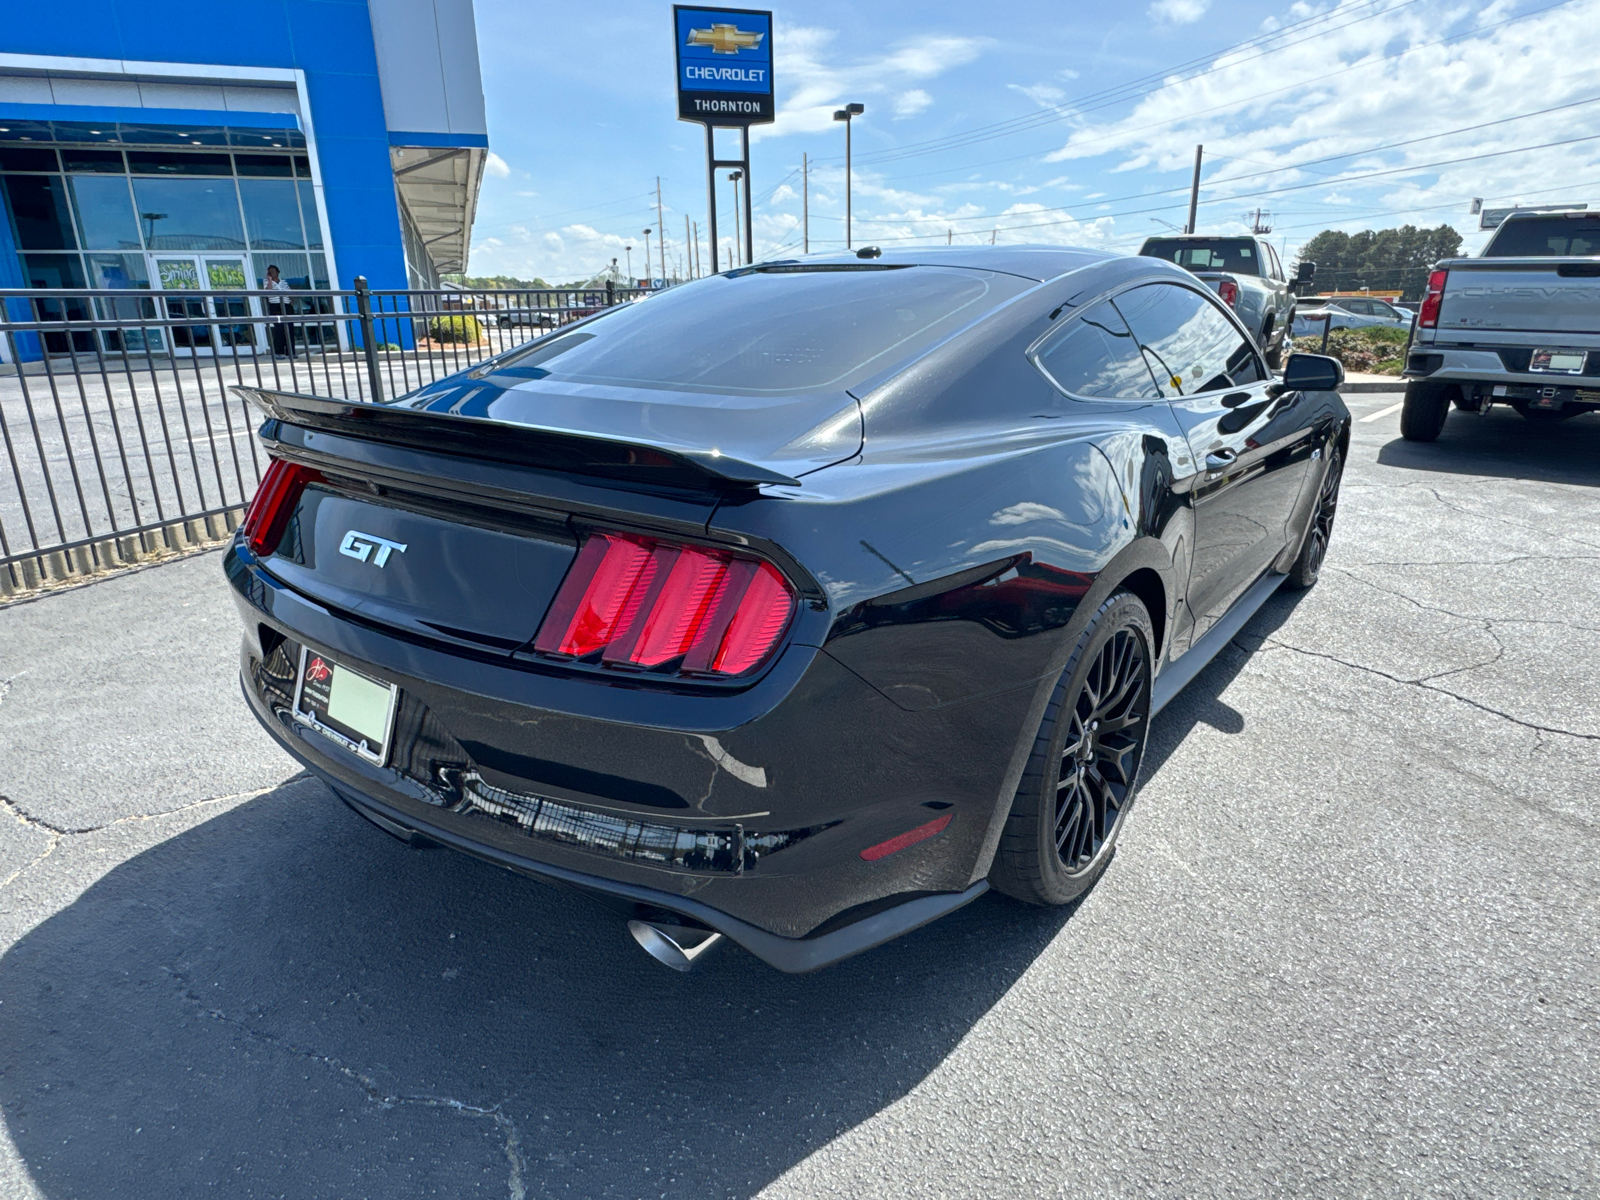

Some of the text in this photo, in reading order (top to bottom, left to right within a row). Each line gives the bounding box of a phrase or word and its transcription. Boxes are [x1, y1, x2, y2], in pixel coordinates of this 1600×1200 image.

[686, 66, 765, 81] CHEVROLET
[694, 99, 760, 113] THORNTON
[211, 270, 245, 285] SALES
[1461, 286, 1600, 300] CHEVR
[339, 530, 407, 568] GT
